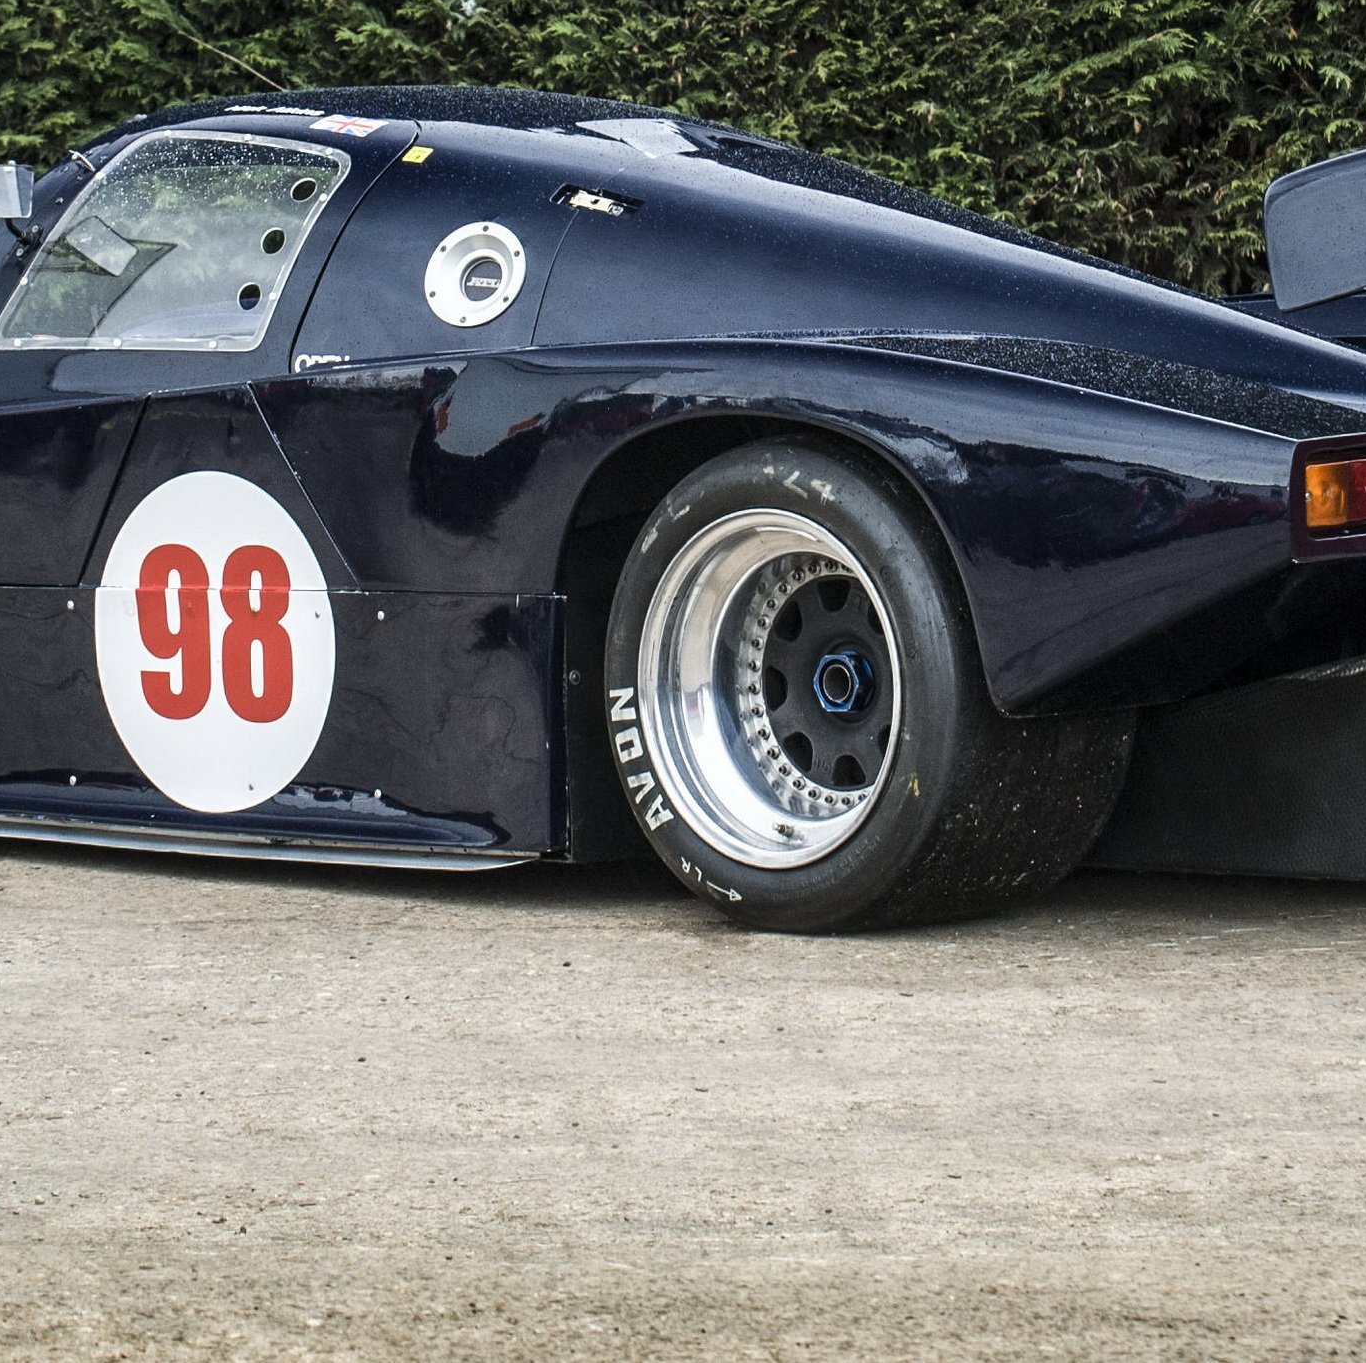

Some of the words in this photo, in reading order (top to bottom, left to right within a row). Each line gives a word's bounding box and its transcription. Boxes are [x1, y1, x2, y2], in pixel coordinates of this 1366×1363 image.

[295, 353, 350, 373] OP
[135, 543, 293, 723] 98
[609, 687, 675, 831] AVON
